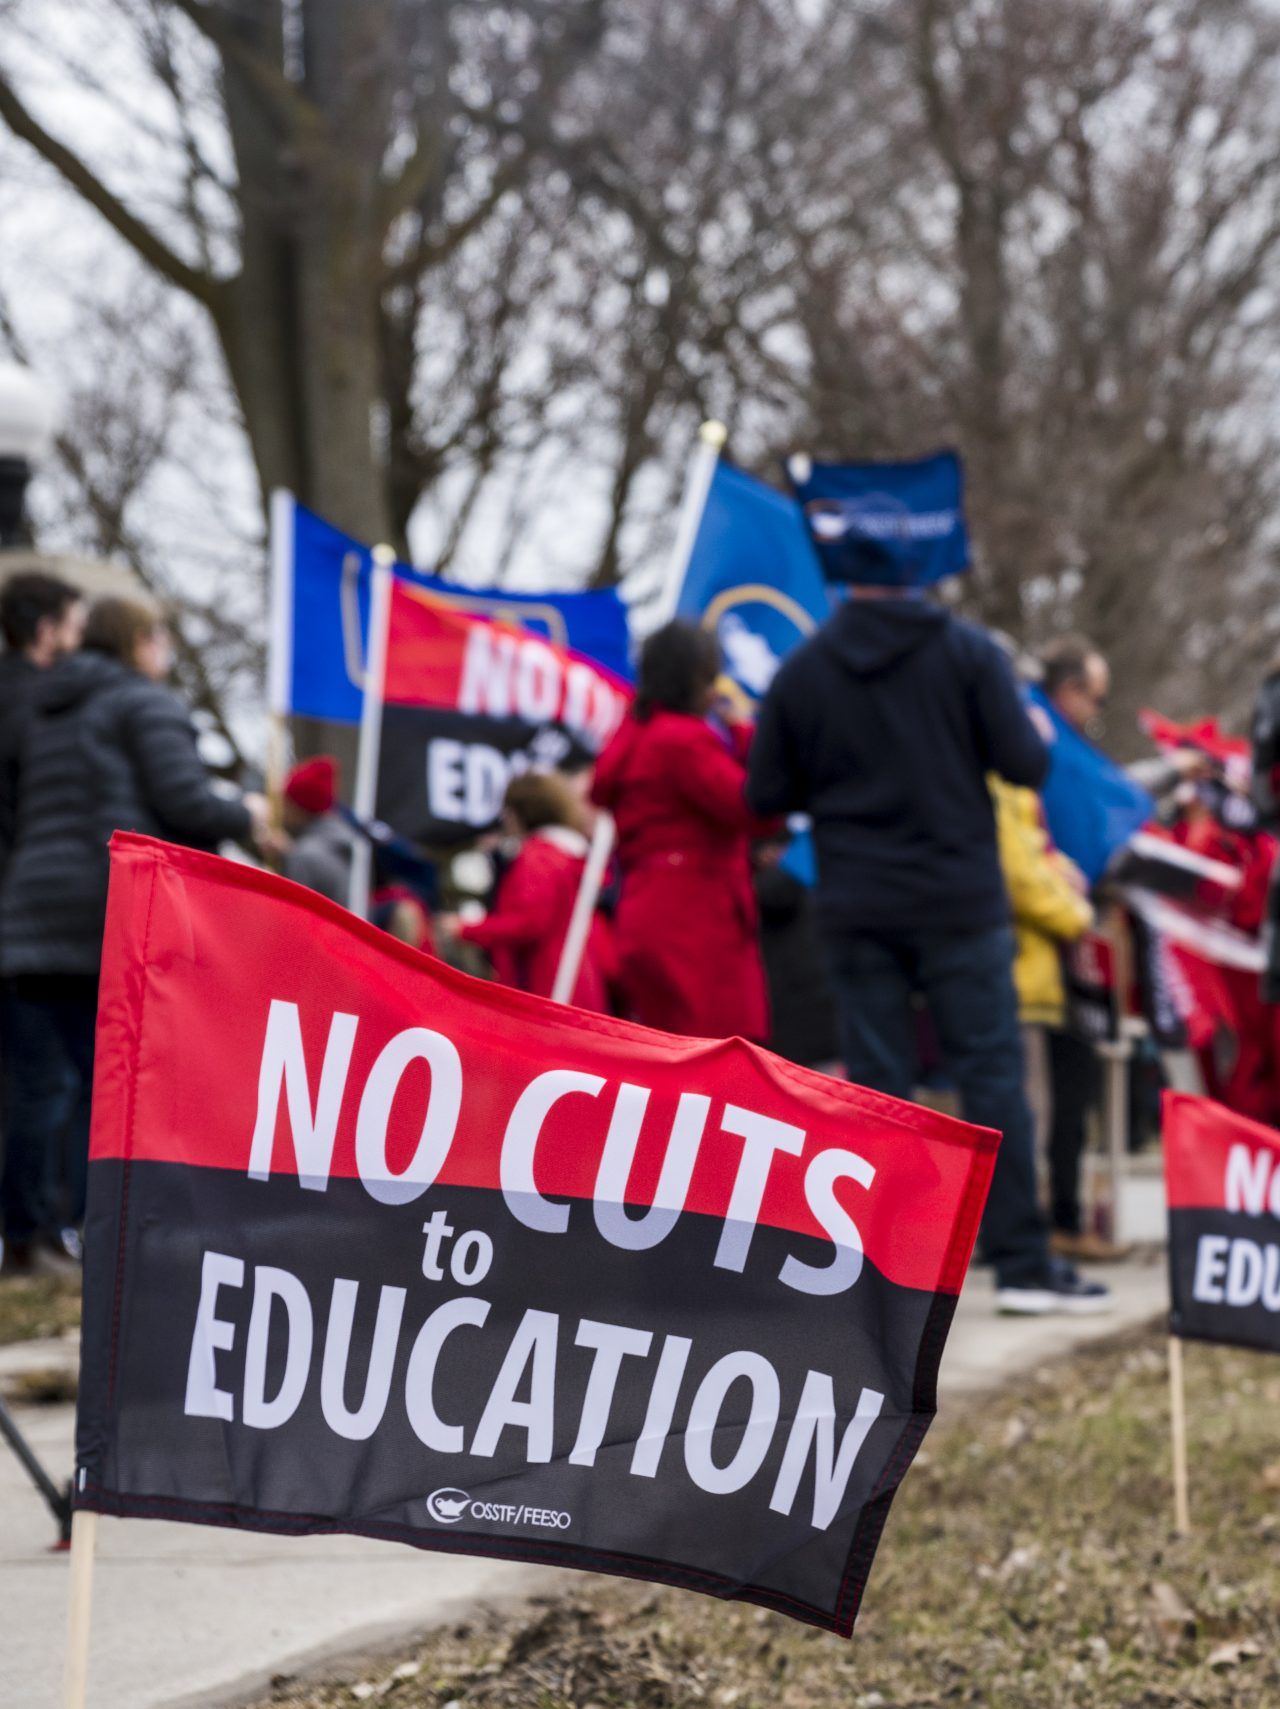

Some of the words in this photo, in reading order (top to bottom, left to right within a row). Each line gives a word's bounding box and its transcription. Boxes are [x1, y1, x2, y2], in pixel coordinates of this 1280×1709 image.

[458, 624, 561, 724] NO
[247, 998, 463, 1206] NO
[499, 1069, 876, 1296] CUTS
[420, 1210, 494, 1286] to
[184, 1250, 885, 1531] EDUCATION
[470, 1501, 572, 1529] OSSTF/FEESO
